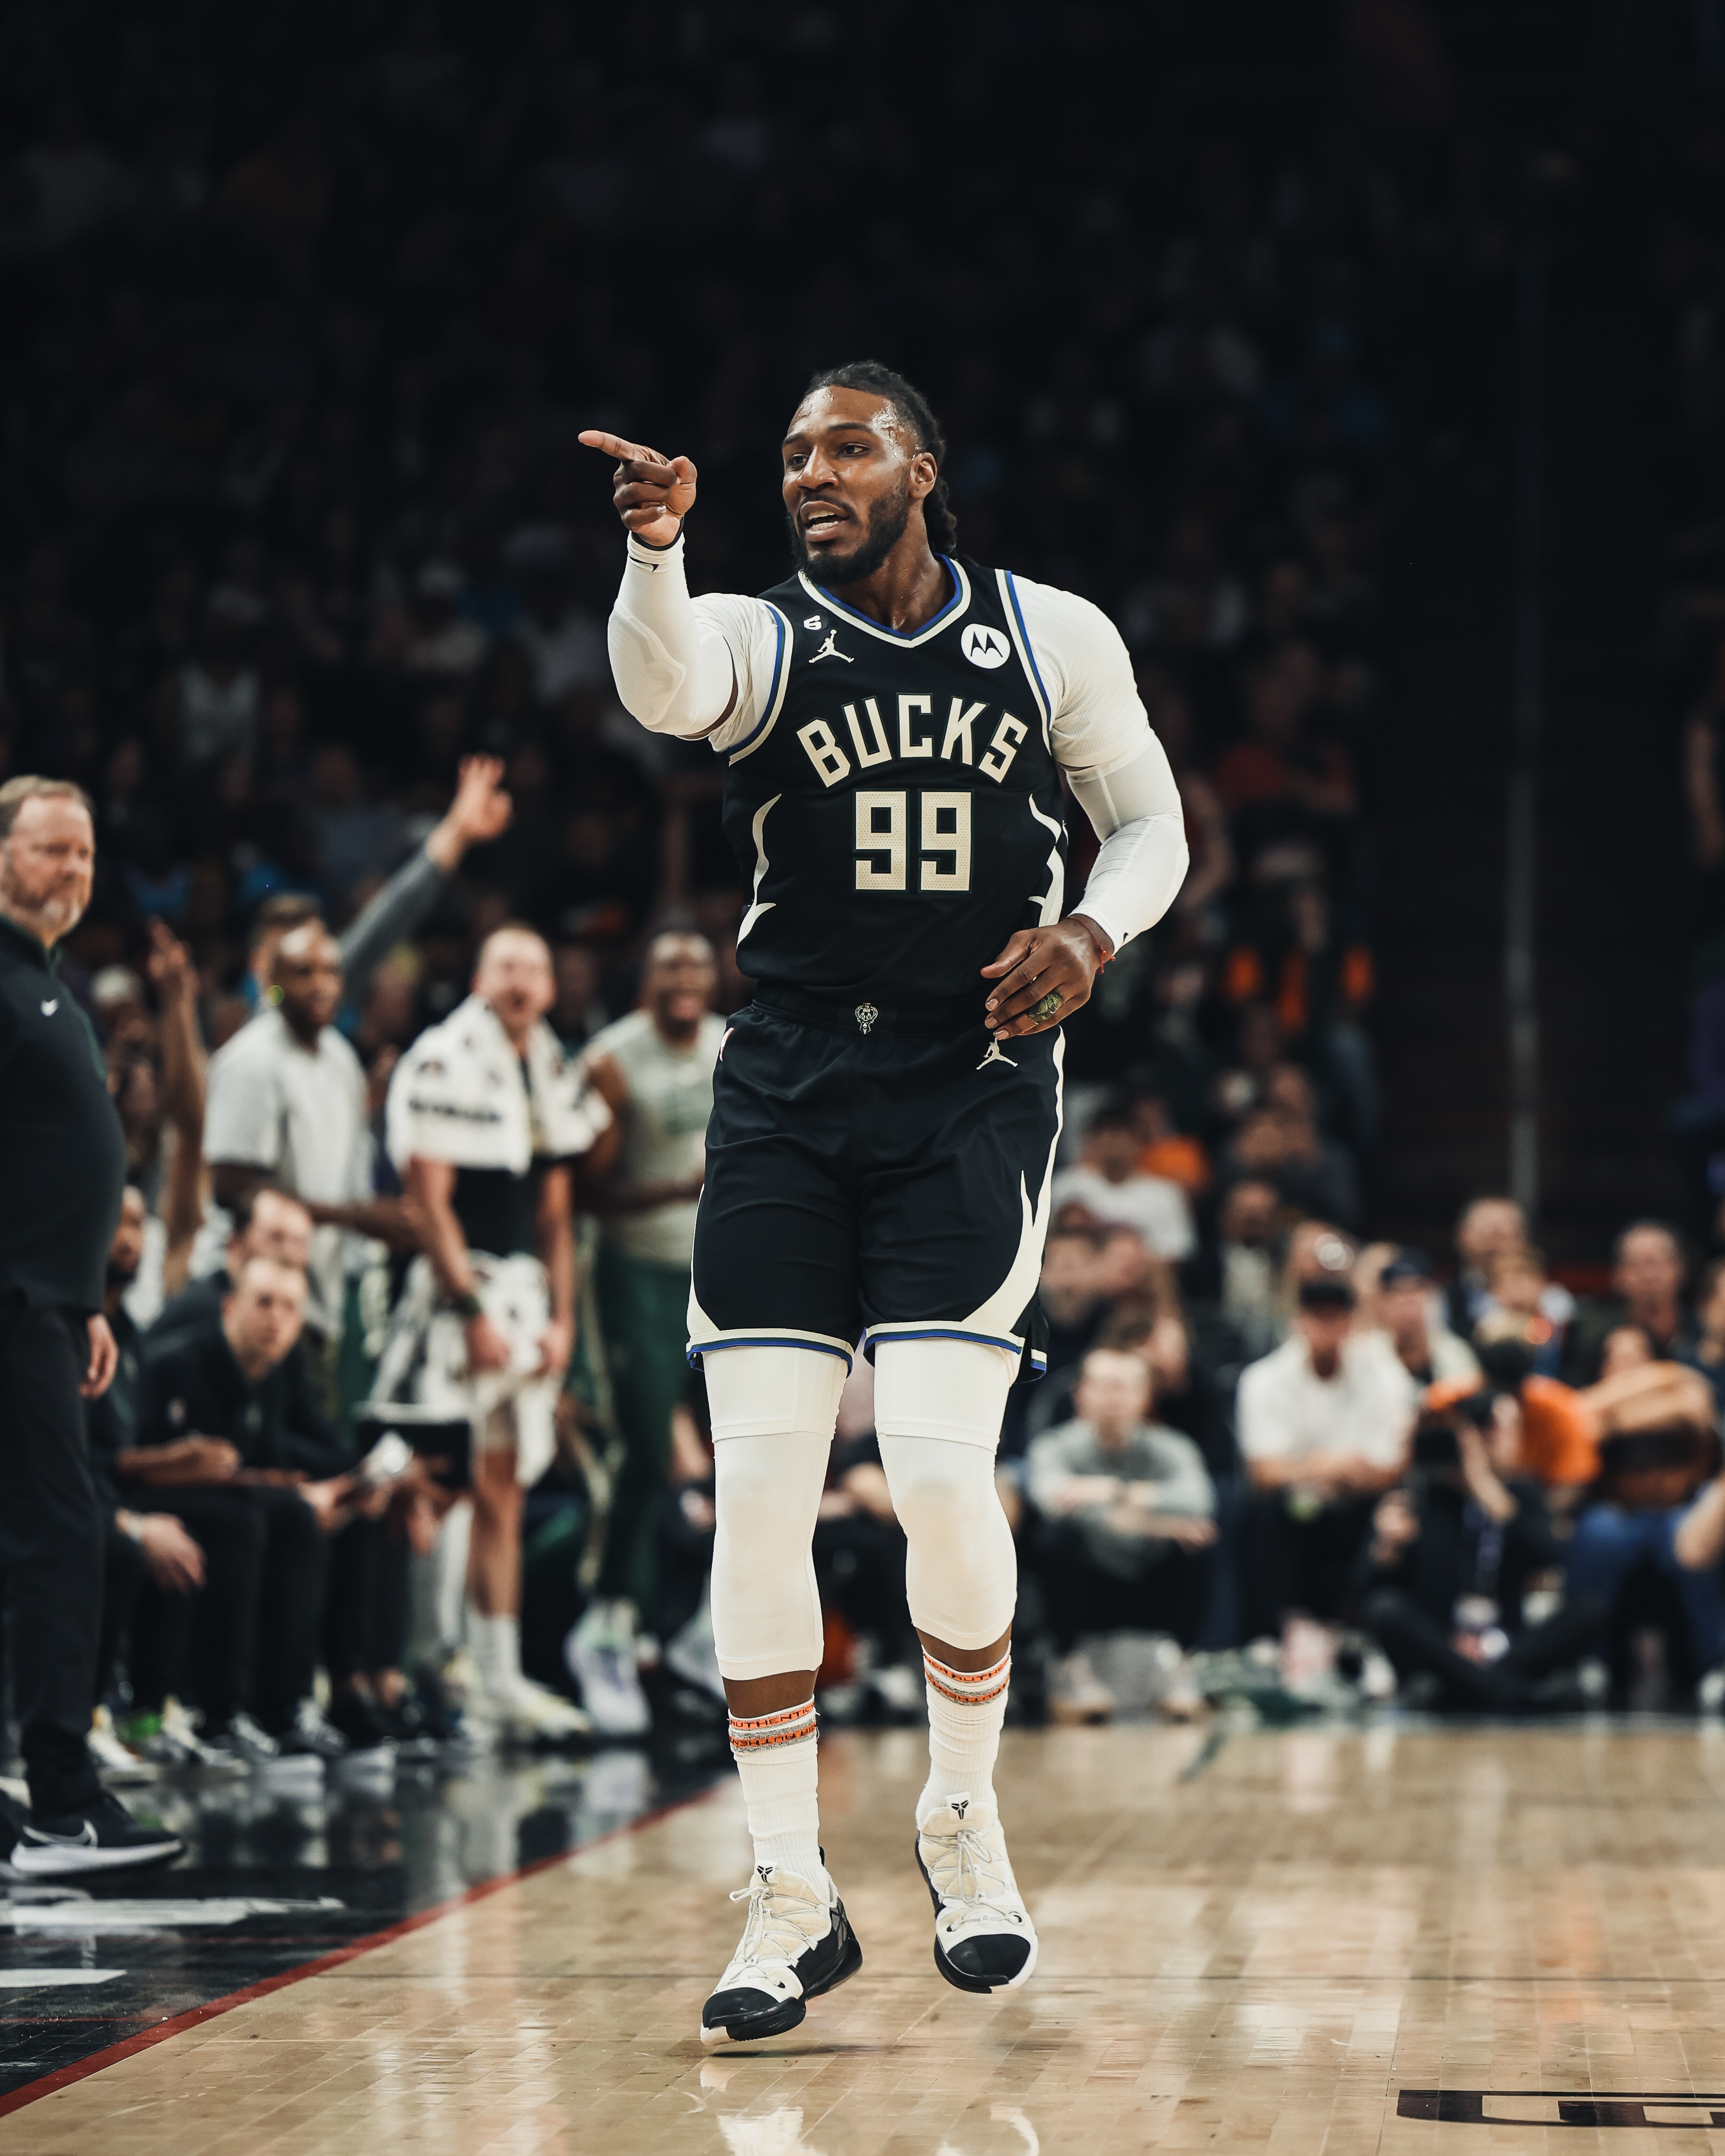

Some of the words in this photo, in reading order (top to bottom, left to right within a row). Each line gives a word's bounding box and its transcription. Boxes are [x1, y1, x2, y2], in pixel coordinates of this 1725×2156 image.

[803, 615, 822, 630] 6
[797, 693, 1029, 788] BUCKS
[854, 789, 974, 892] 99
